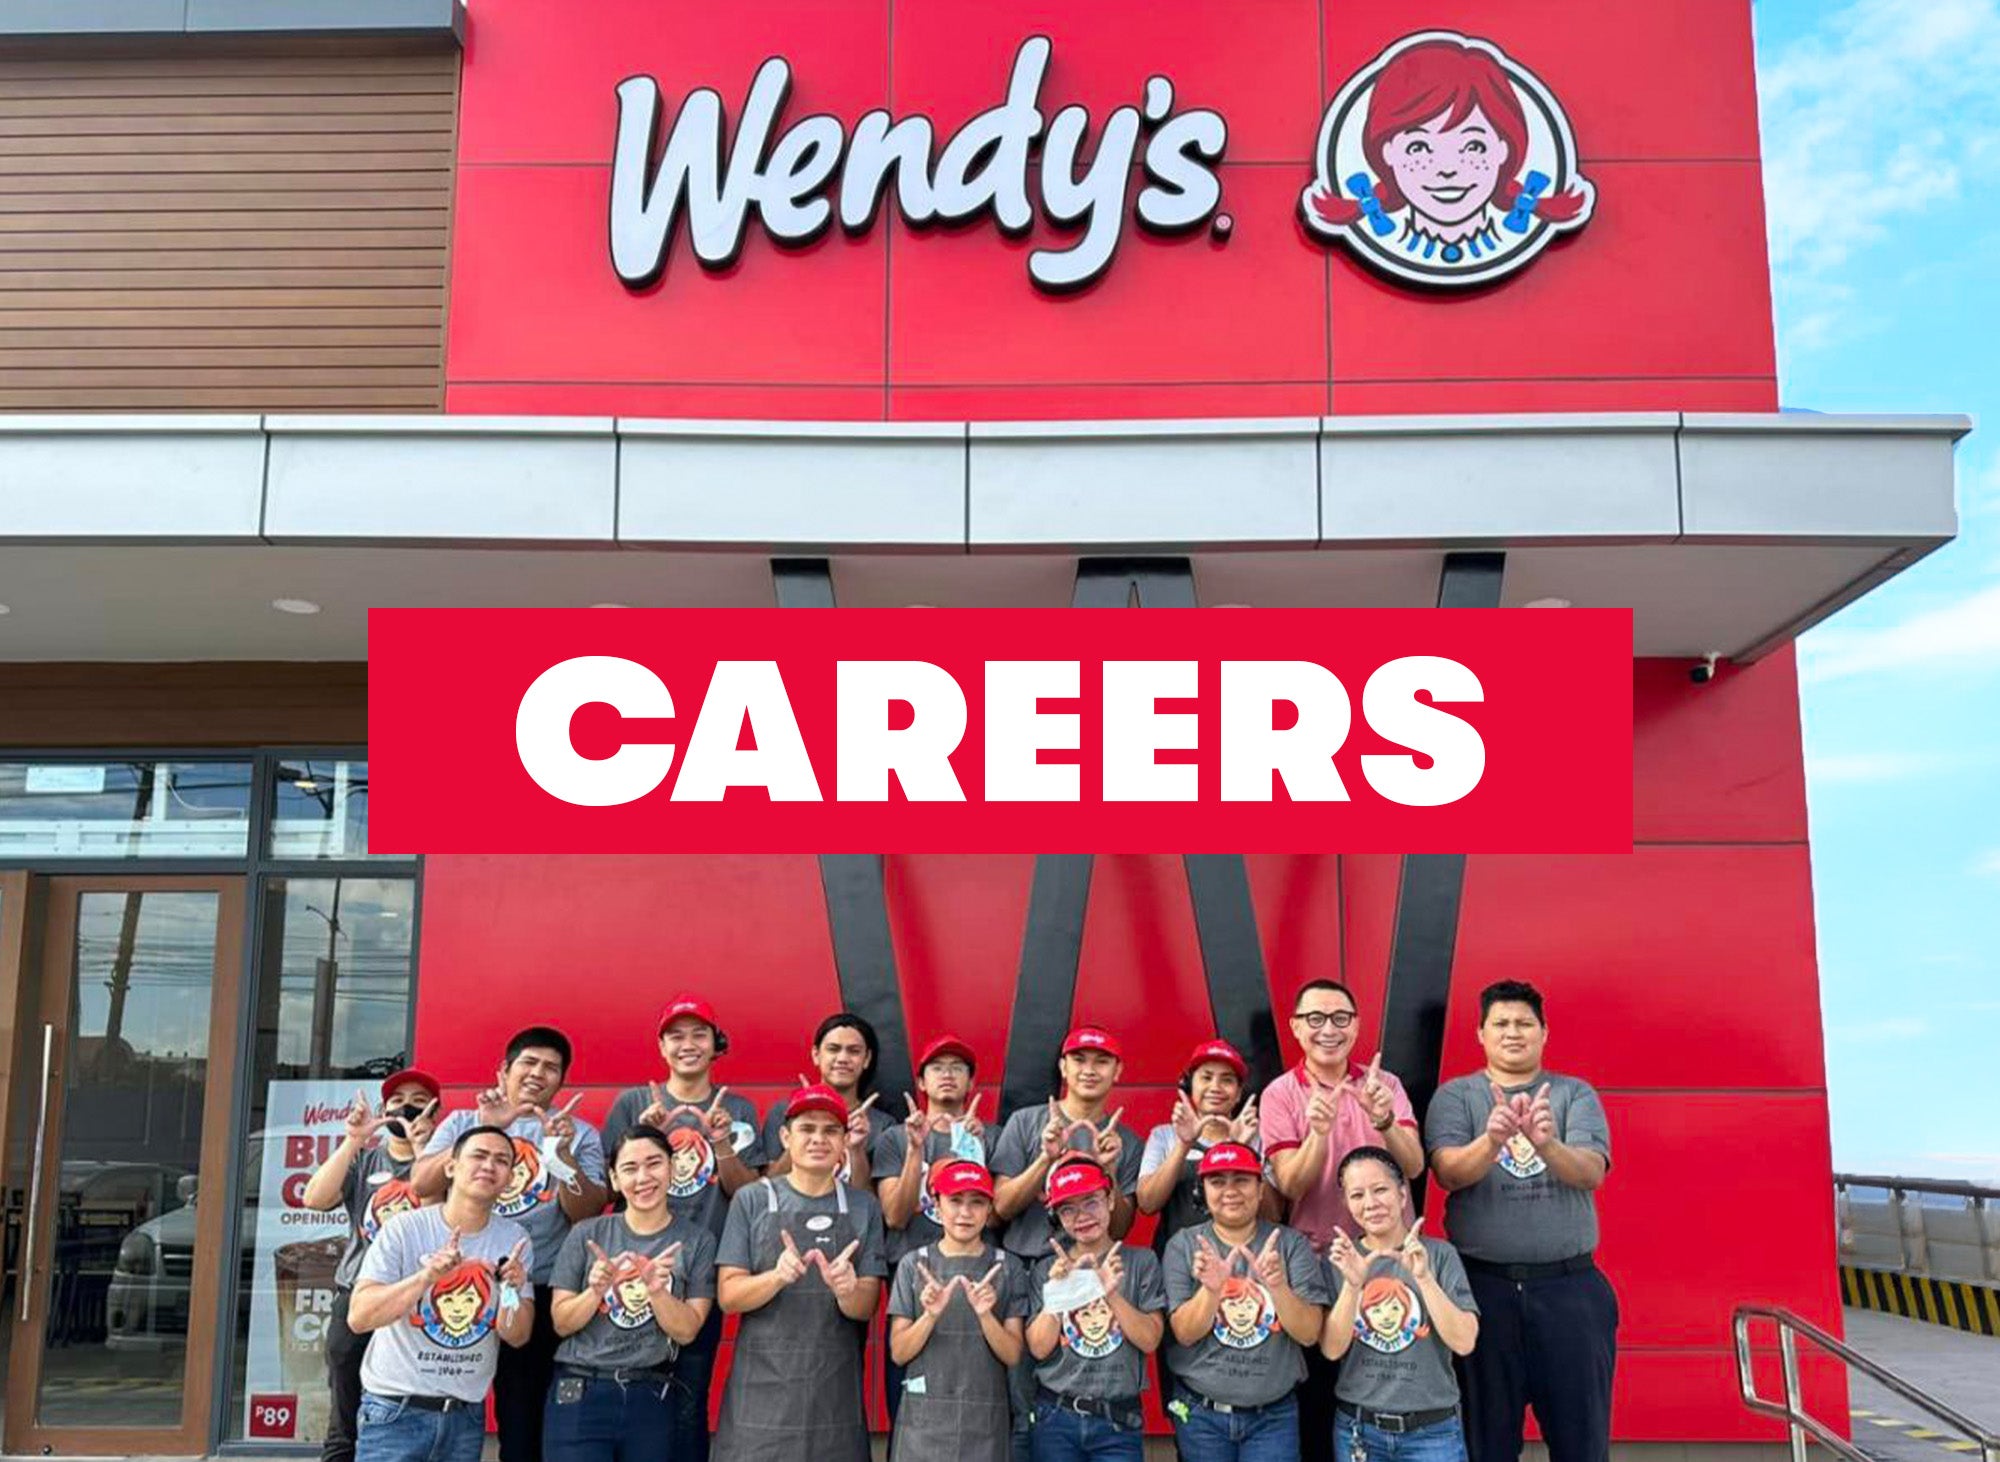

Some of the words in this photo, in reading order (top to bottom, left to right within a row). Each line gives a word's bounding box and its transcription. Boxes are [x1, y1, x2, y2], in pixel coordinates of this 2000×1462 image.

[612, 36, 1226, 288] Wendy's
[303, 1100, 353, 1127] Wend
[281, 1213, 348, 1225] OPENING
